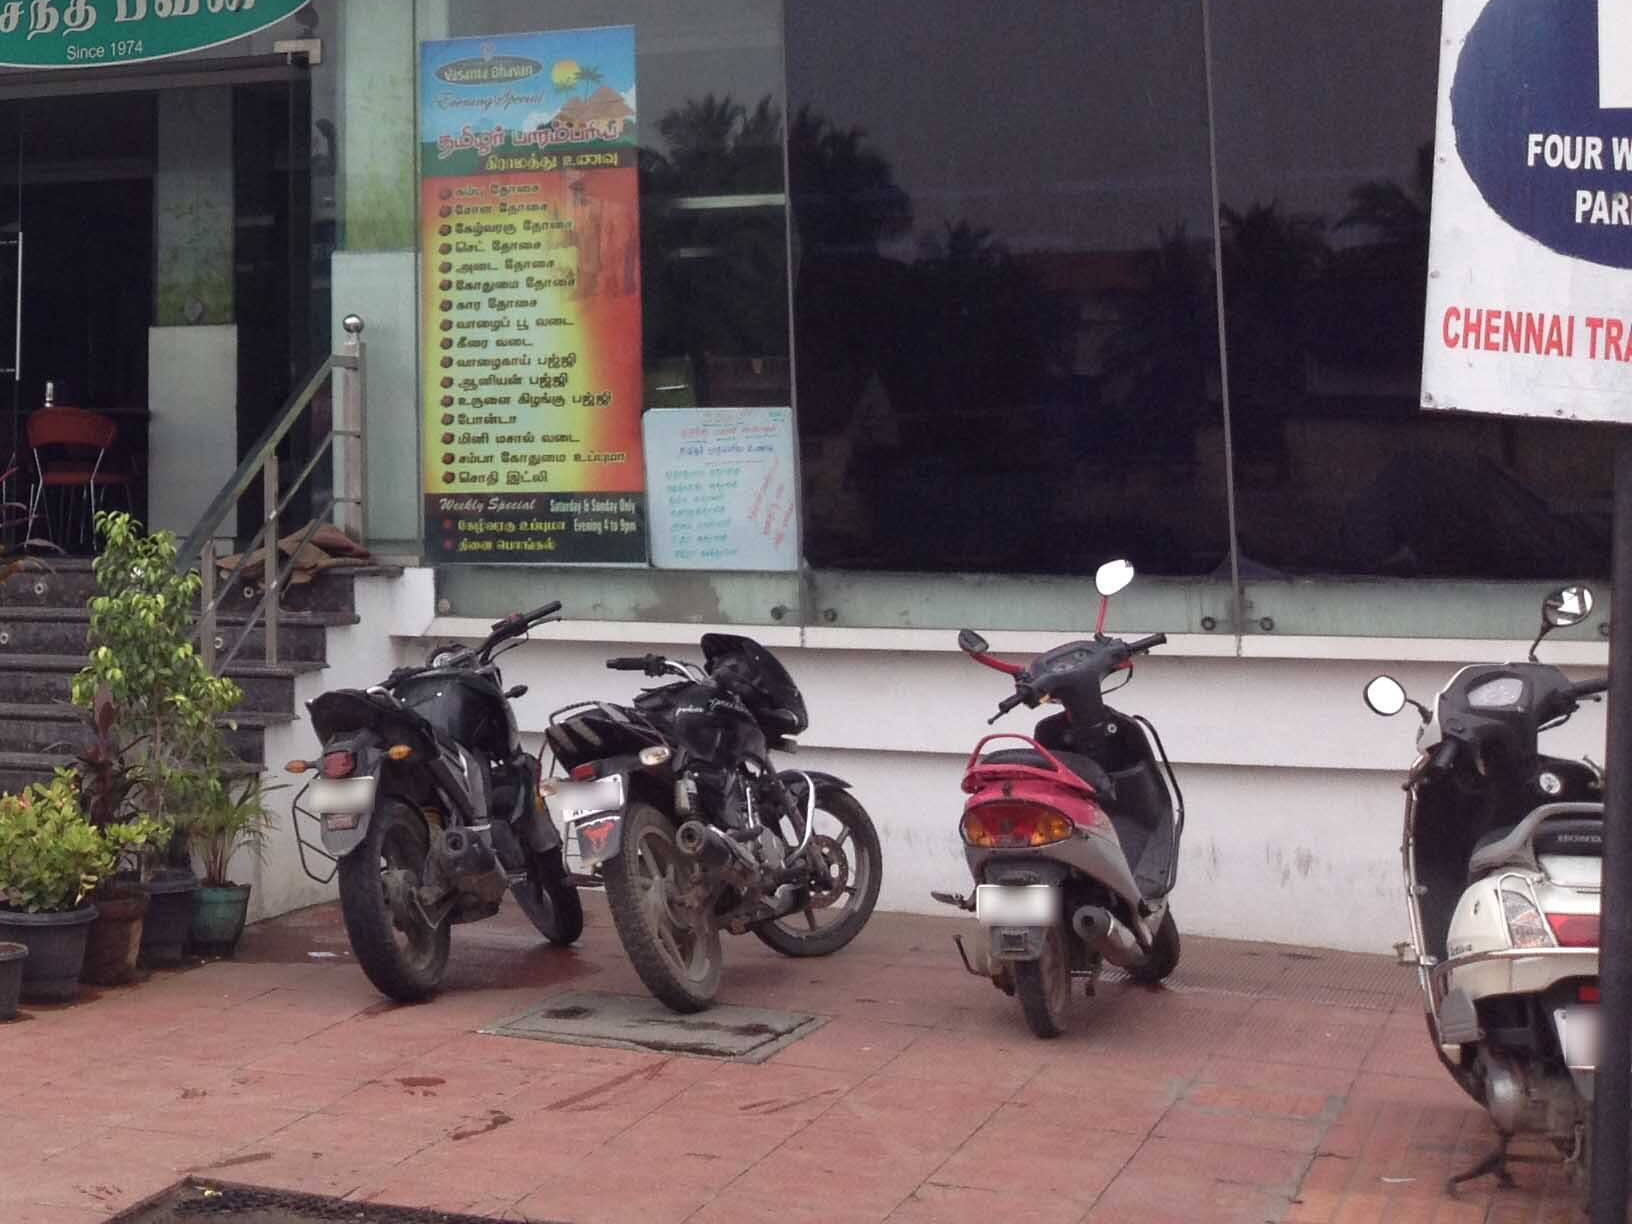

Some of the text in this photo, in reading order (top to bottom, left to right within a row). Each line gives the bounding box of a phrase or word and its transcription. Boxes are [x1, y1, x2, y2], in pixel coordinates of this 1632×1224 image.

[67, 40, 143, 61] Since 1974
[1527, 133, 1603, 170] FOUR
[1442, 306, 1576, 357] CHENNAI
[440, 498, 536, 513] Weekly Special
